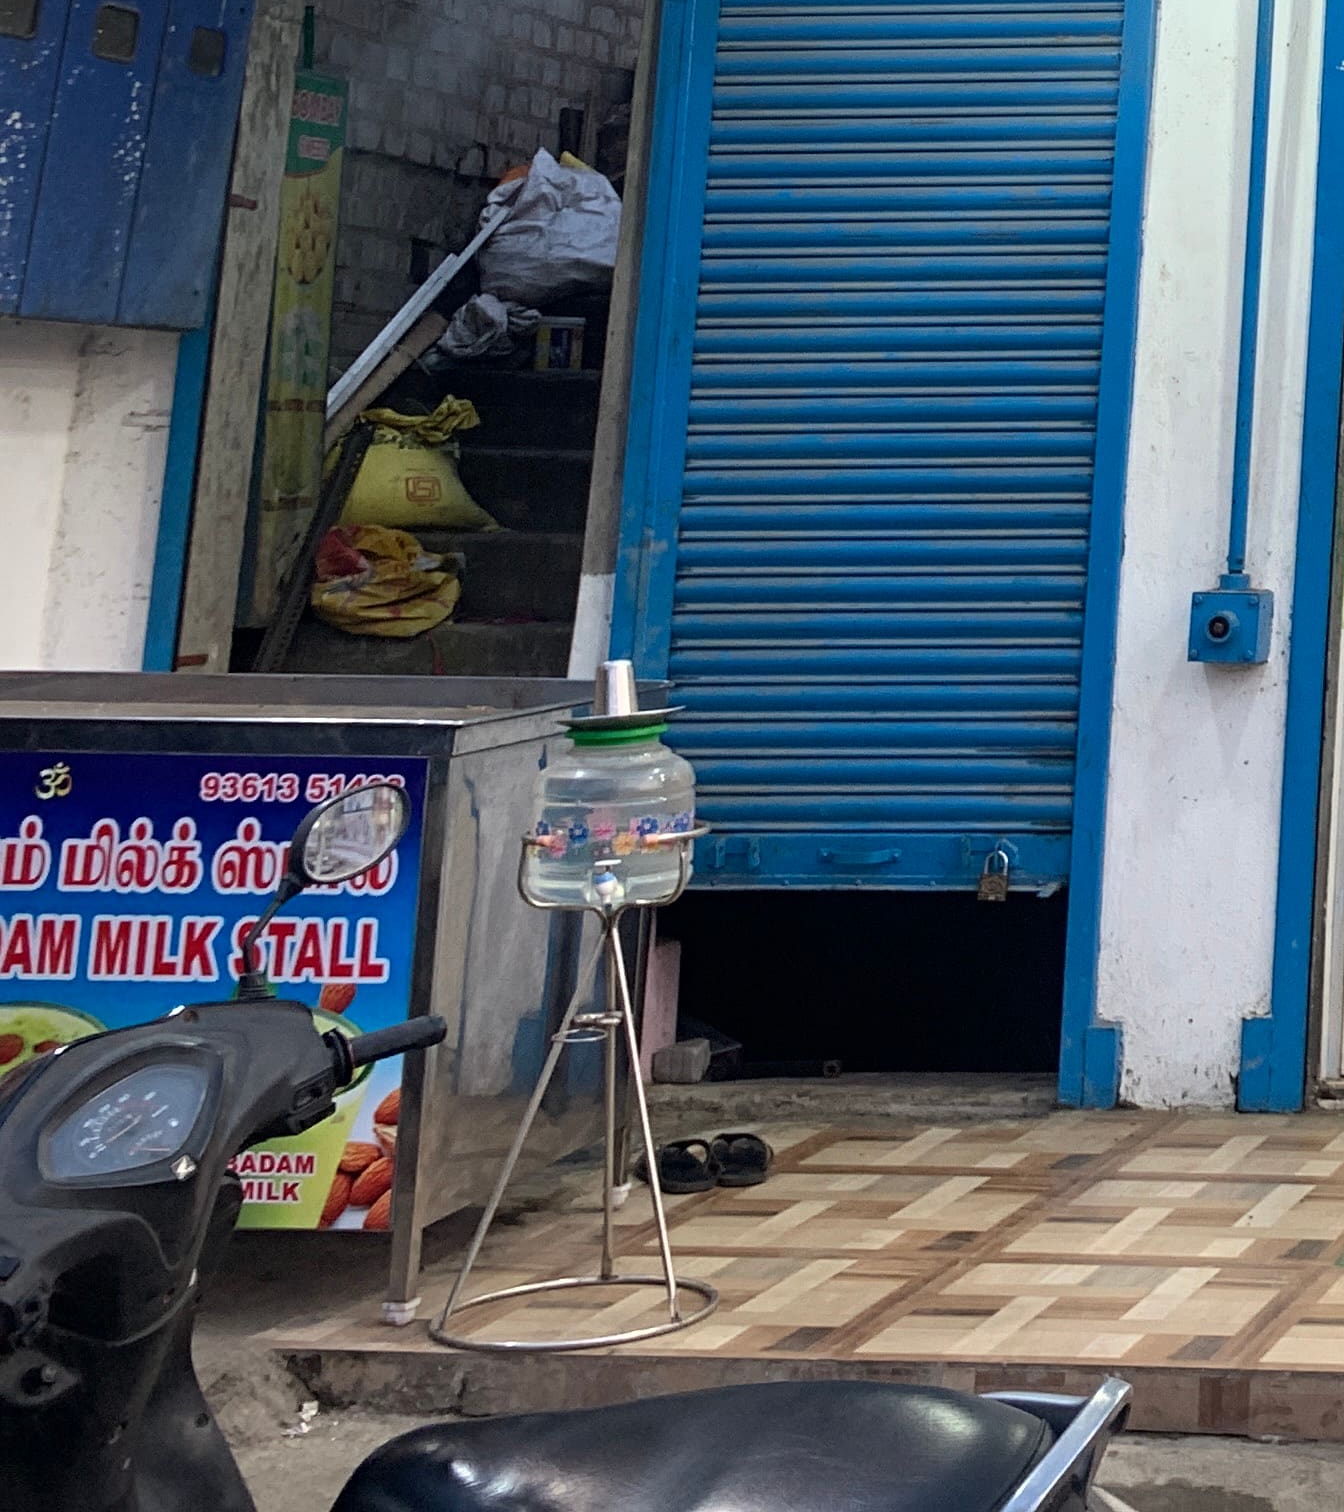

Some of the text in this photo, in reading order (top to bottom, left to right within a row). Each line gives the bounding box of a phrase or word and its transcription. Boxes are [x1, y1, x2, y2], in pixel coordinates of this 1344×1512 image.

[202, 775, 404, 801] 93613 514
[63, 821, 200, 888] மில்க்
[0, 918, 385, 978] AM MILK STALL
